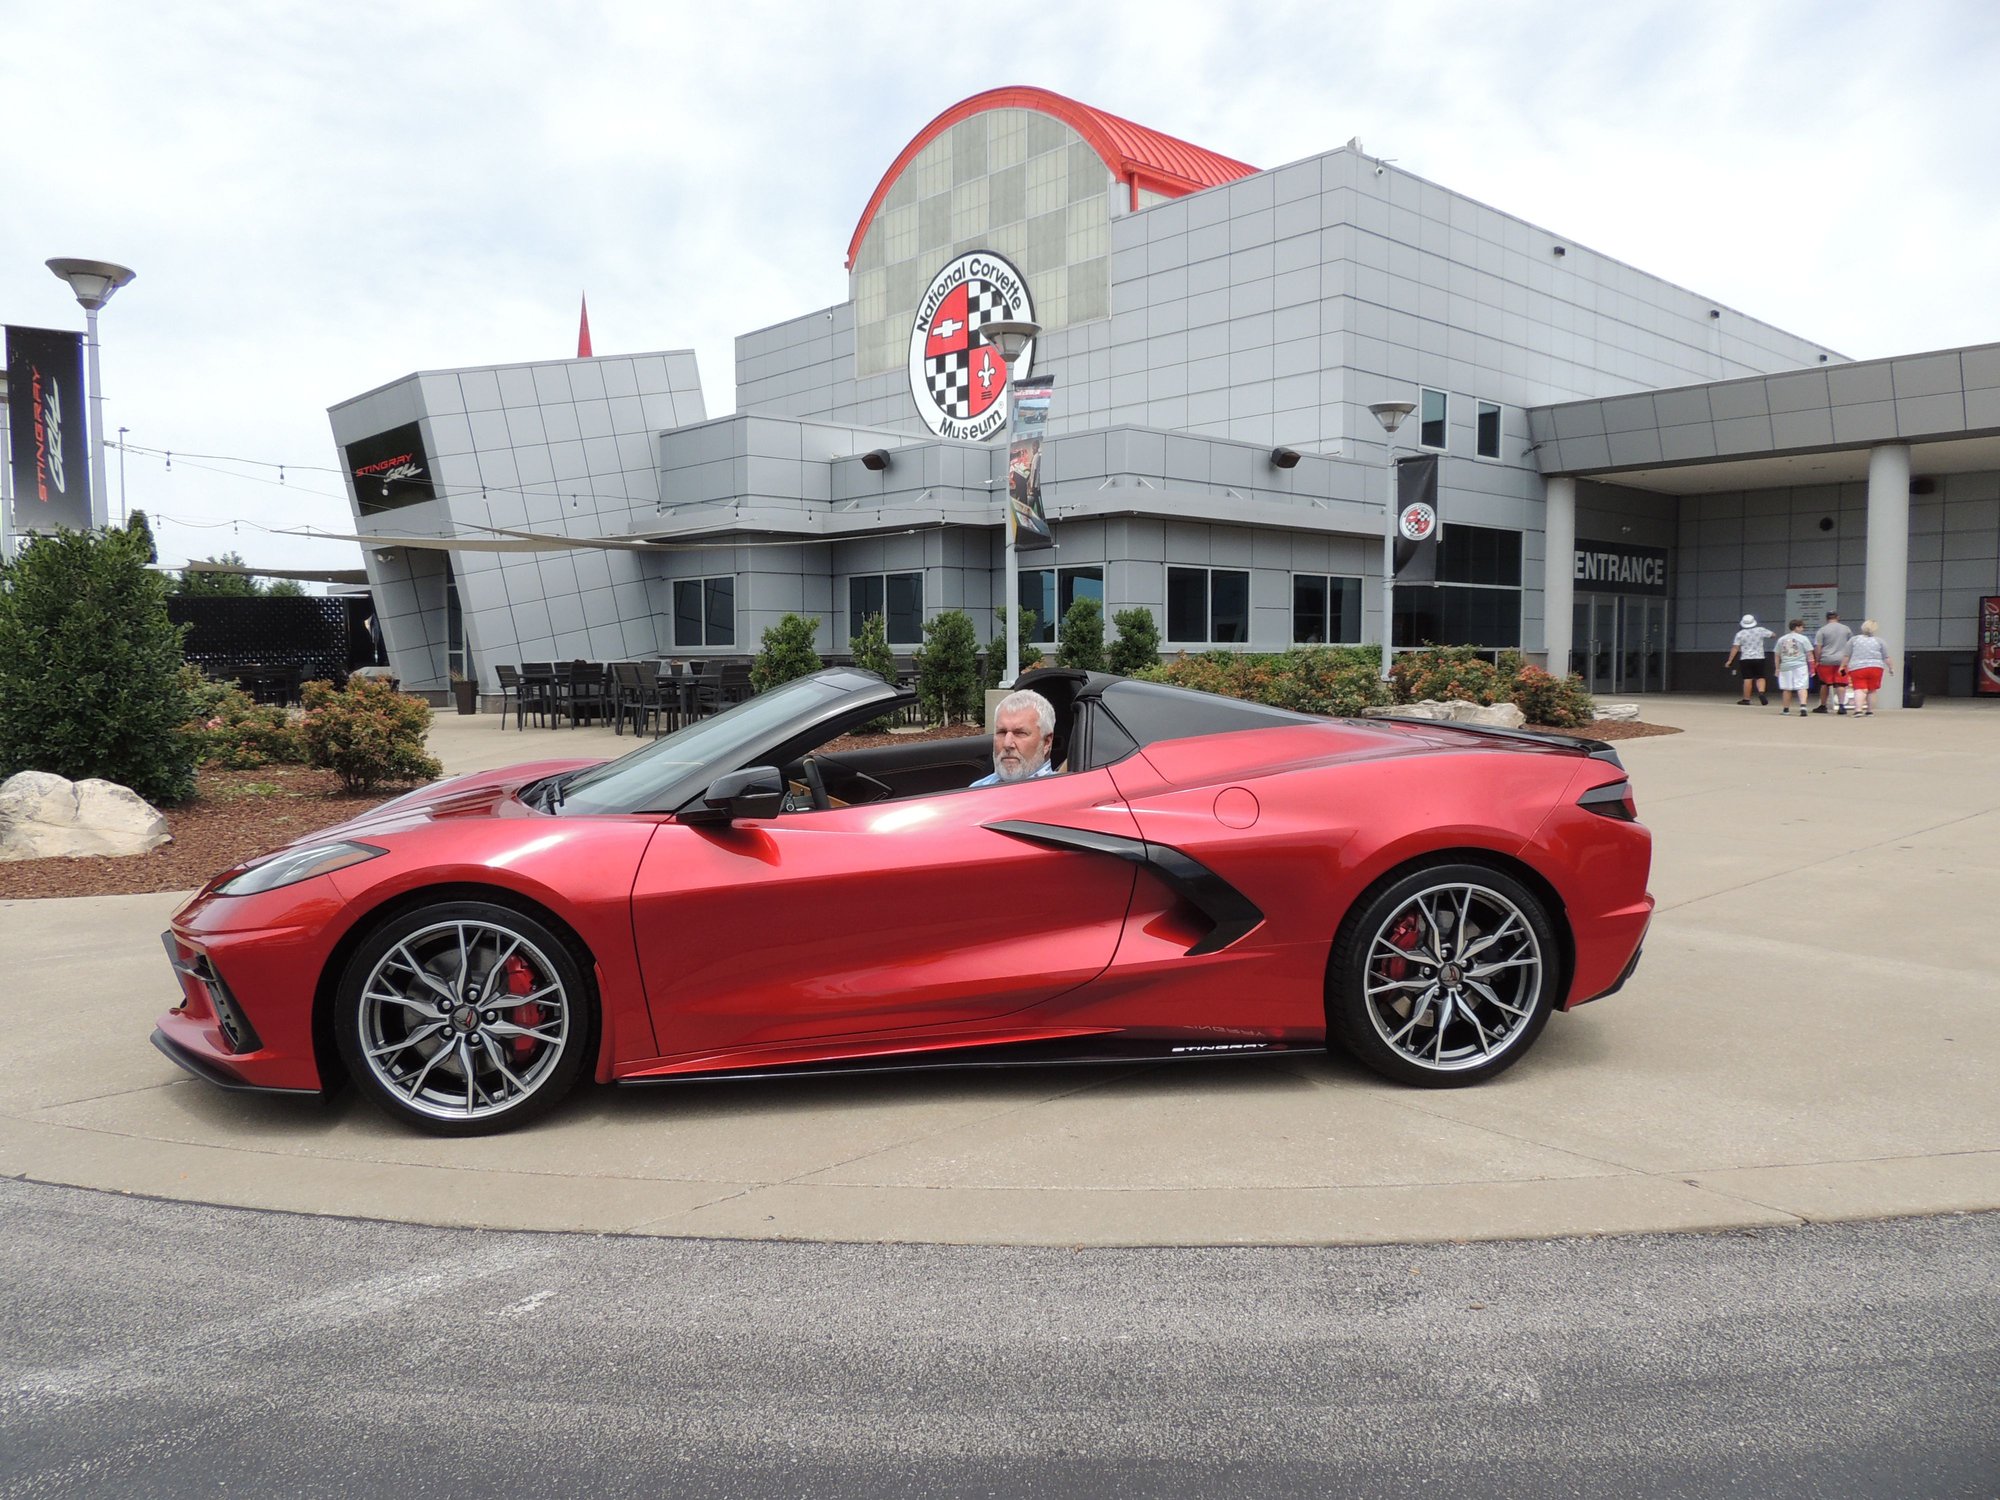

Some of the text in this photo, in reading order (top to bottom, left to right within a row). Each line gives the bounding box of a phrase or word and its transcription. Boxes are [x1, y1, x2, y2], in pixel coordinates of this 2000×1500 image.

[916, 257, 1023, 334] National Corvette
[31, 363, 48, 503] STINGRAY
[938, 408, 1003, 441] Museum
[355, 453, 413, 478] STINGRAY
[1574, 550, 1664, 585] ENTRANCE
[1171, 1043, 1269, 1053] STINGRAY
